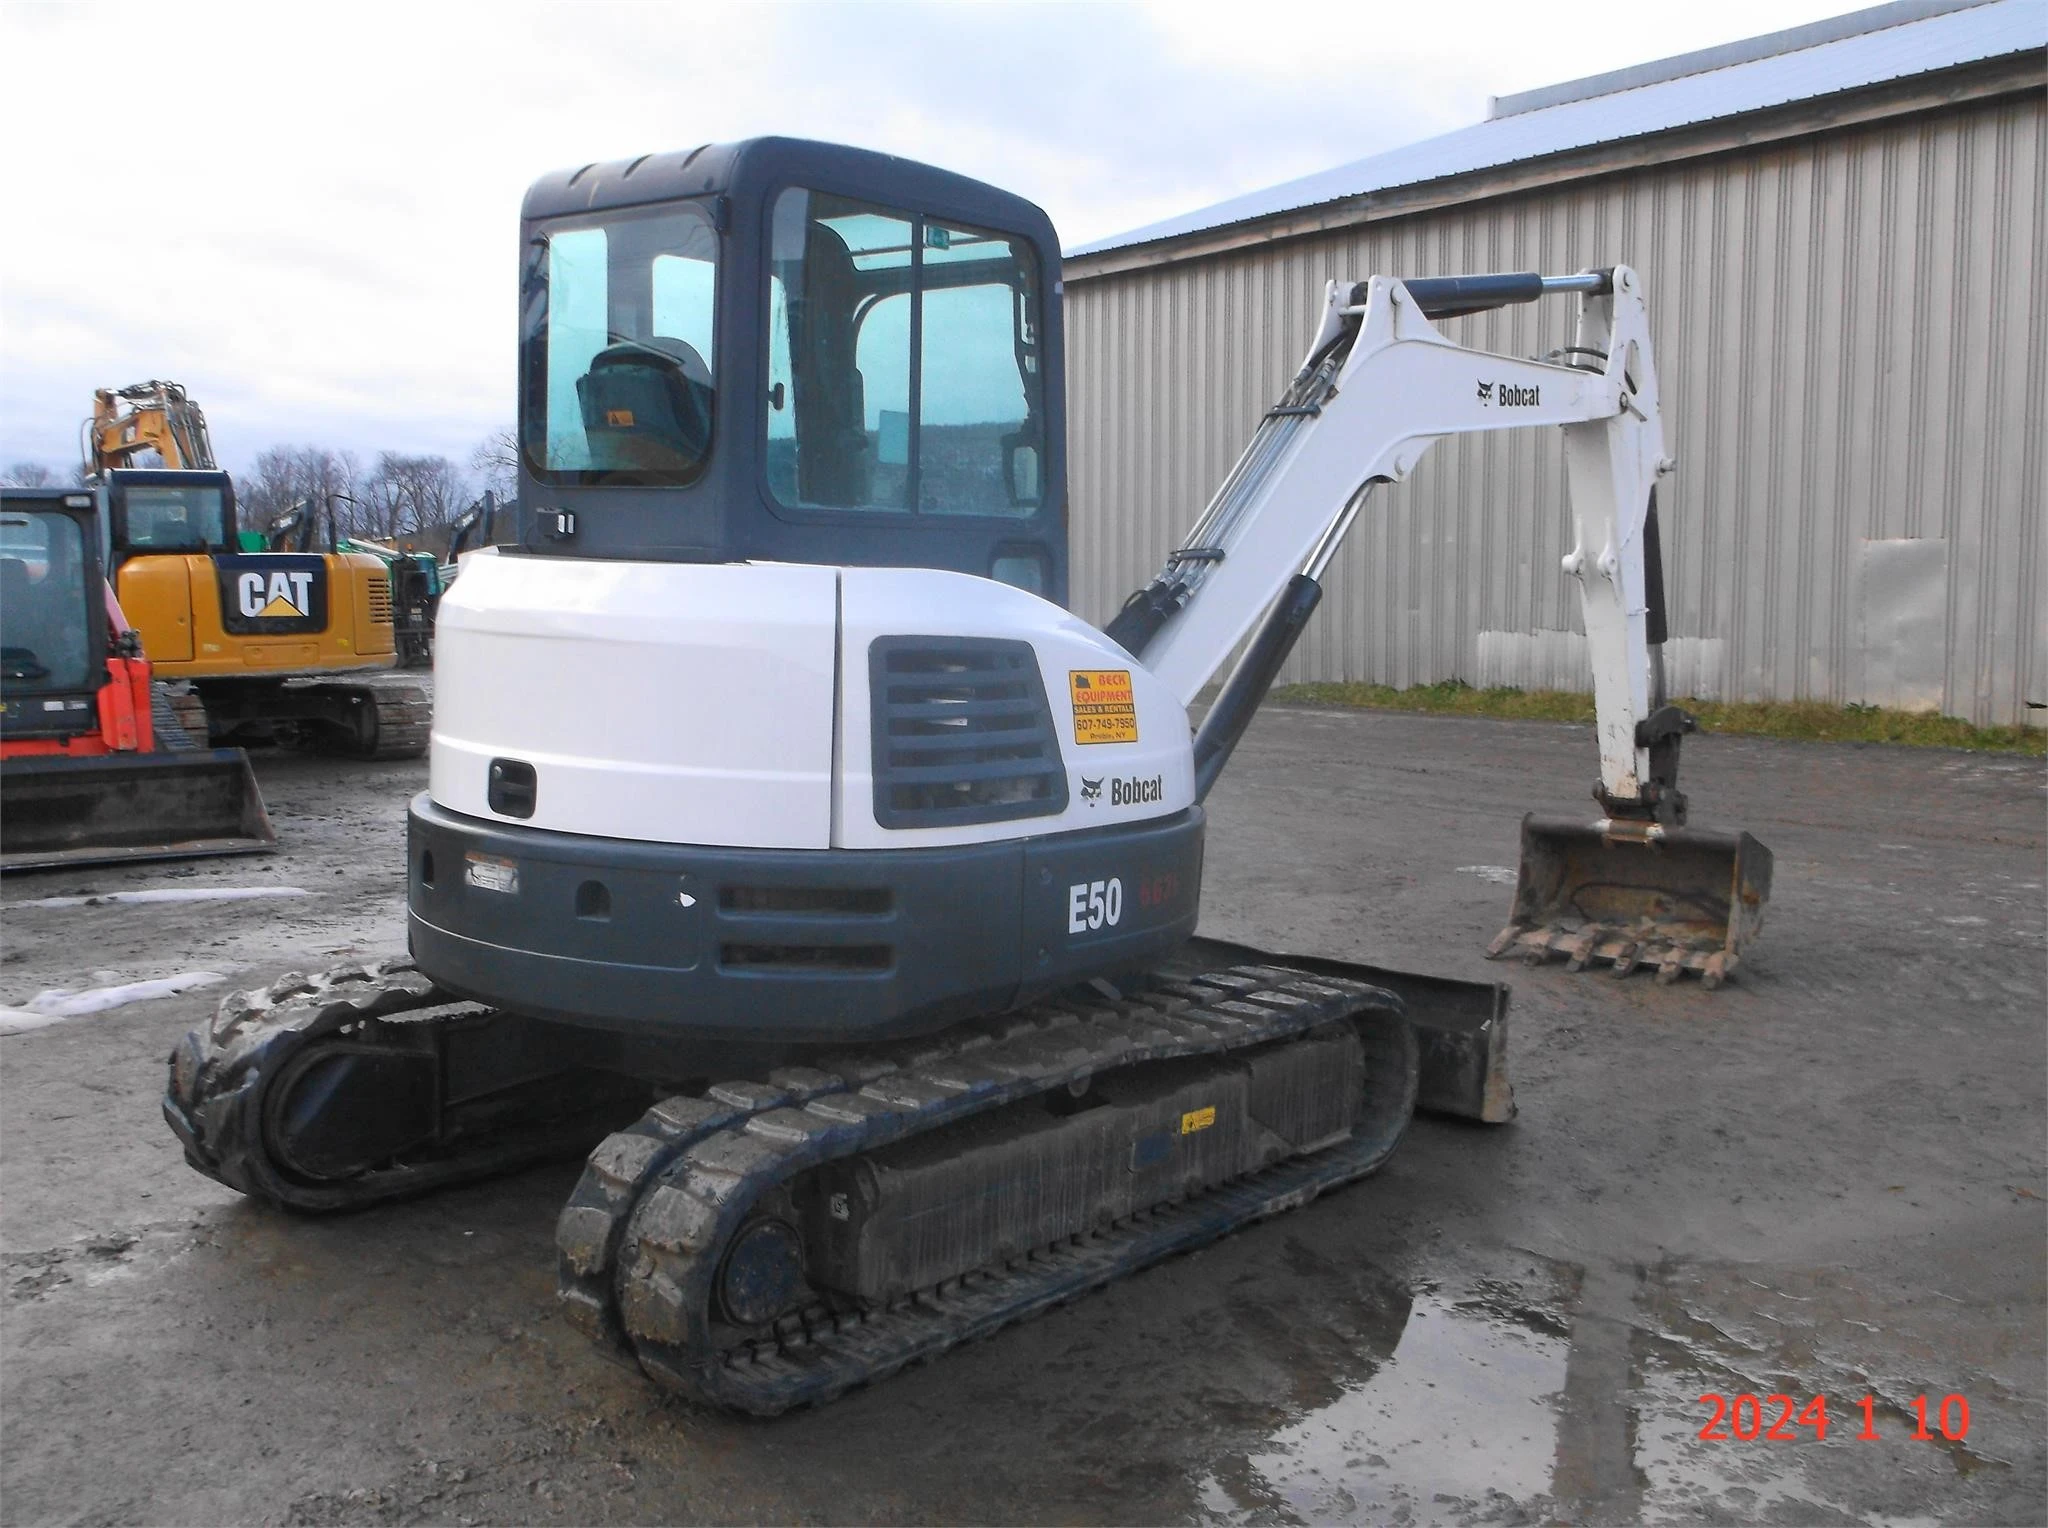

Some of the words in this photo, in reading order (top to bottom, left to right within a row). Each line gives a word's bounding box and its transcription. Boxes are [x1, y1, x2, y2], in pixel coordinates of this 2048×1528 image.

[1499, 384, 1540, 406] Bobcat
[239, 572, 314, 618] CAT
[1099, 674, 1126, 685] BECK
[1076, 690, 1132, 703] EQUIPMENT
[1074, 705, 1097, 713] SALES
[1098, 705, 1104, 713] &
[1104, 704, 1133, 713] RENTALS
[1111, 774, 1162, 806] Bobcat
[1068, 877, 1122, 934] E50
